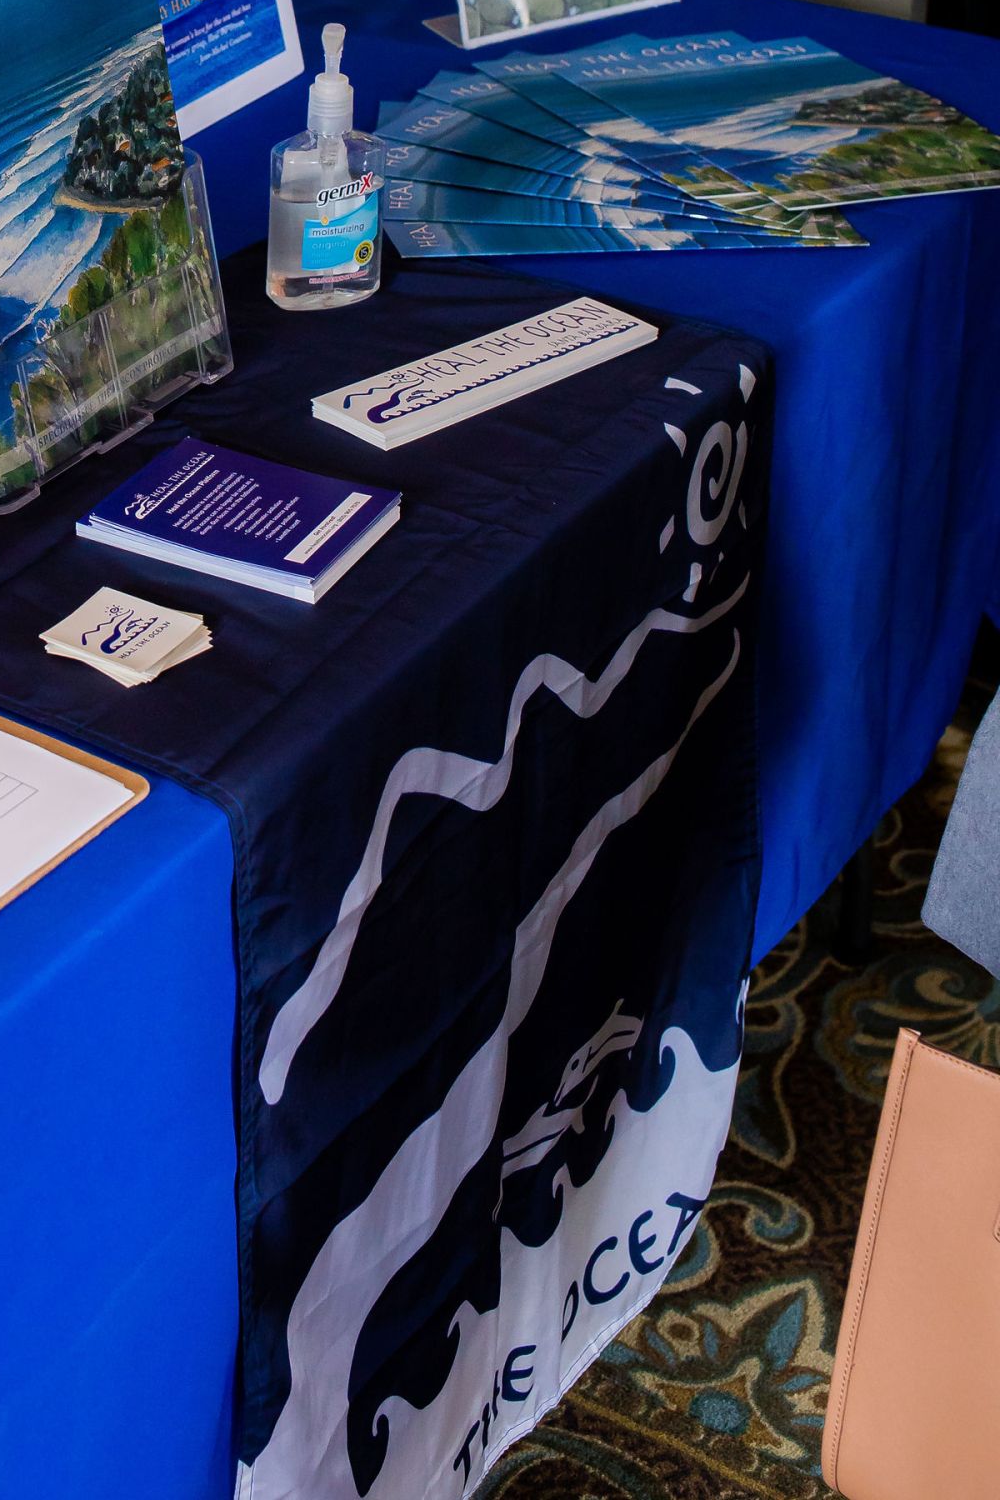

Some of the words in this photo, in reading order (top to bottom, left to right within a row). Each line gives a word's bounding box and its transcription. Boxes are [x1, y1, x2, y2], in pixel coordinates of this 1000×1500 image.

[581, 51, 632, 65] THE
[641, 38, 731, 57] OCEAN
[717, 45, 807, 62] OCEAN
[450, 81, 499, 97] HEA
[405, 107, 458, 134] HEAL
[386, 144, 412, 167] HEA
[317, 172, 373, 207] germ-X
[312, 223, 365, 236] moisturizing
[405, 347, 489, 384] HEAL
[469, 330, 535, 360] THE
[518, 301, 612, 341] OCEAN
[545, 332, 582, 348] SANTA
[575, 315, 625, 337] BARBARA
[142, 342, 178, 370] PROJECT
[149, 481, 173, 497] HEAL
[167, 470, 186, 481] THE
[179, 451, 209, 470] OCEAN
[165, 503, 181, 514] Heal
[183, 485, 202, 498] Ocean
[196, 469, 221, 485] Platform
[118, 646, 138, 660] HEAL
[134, 637, 150, 647] THE
[146, 620, 172, 638] OCEAN
[452, 1344, 538, 1489] THE
